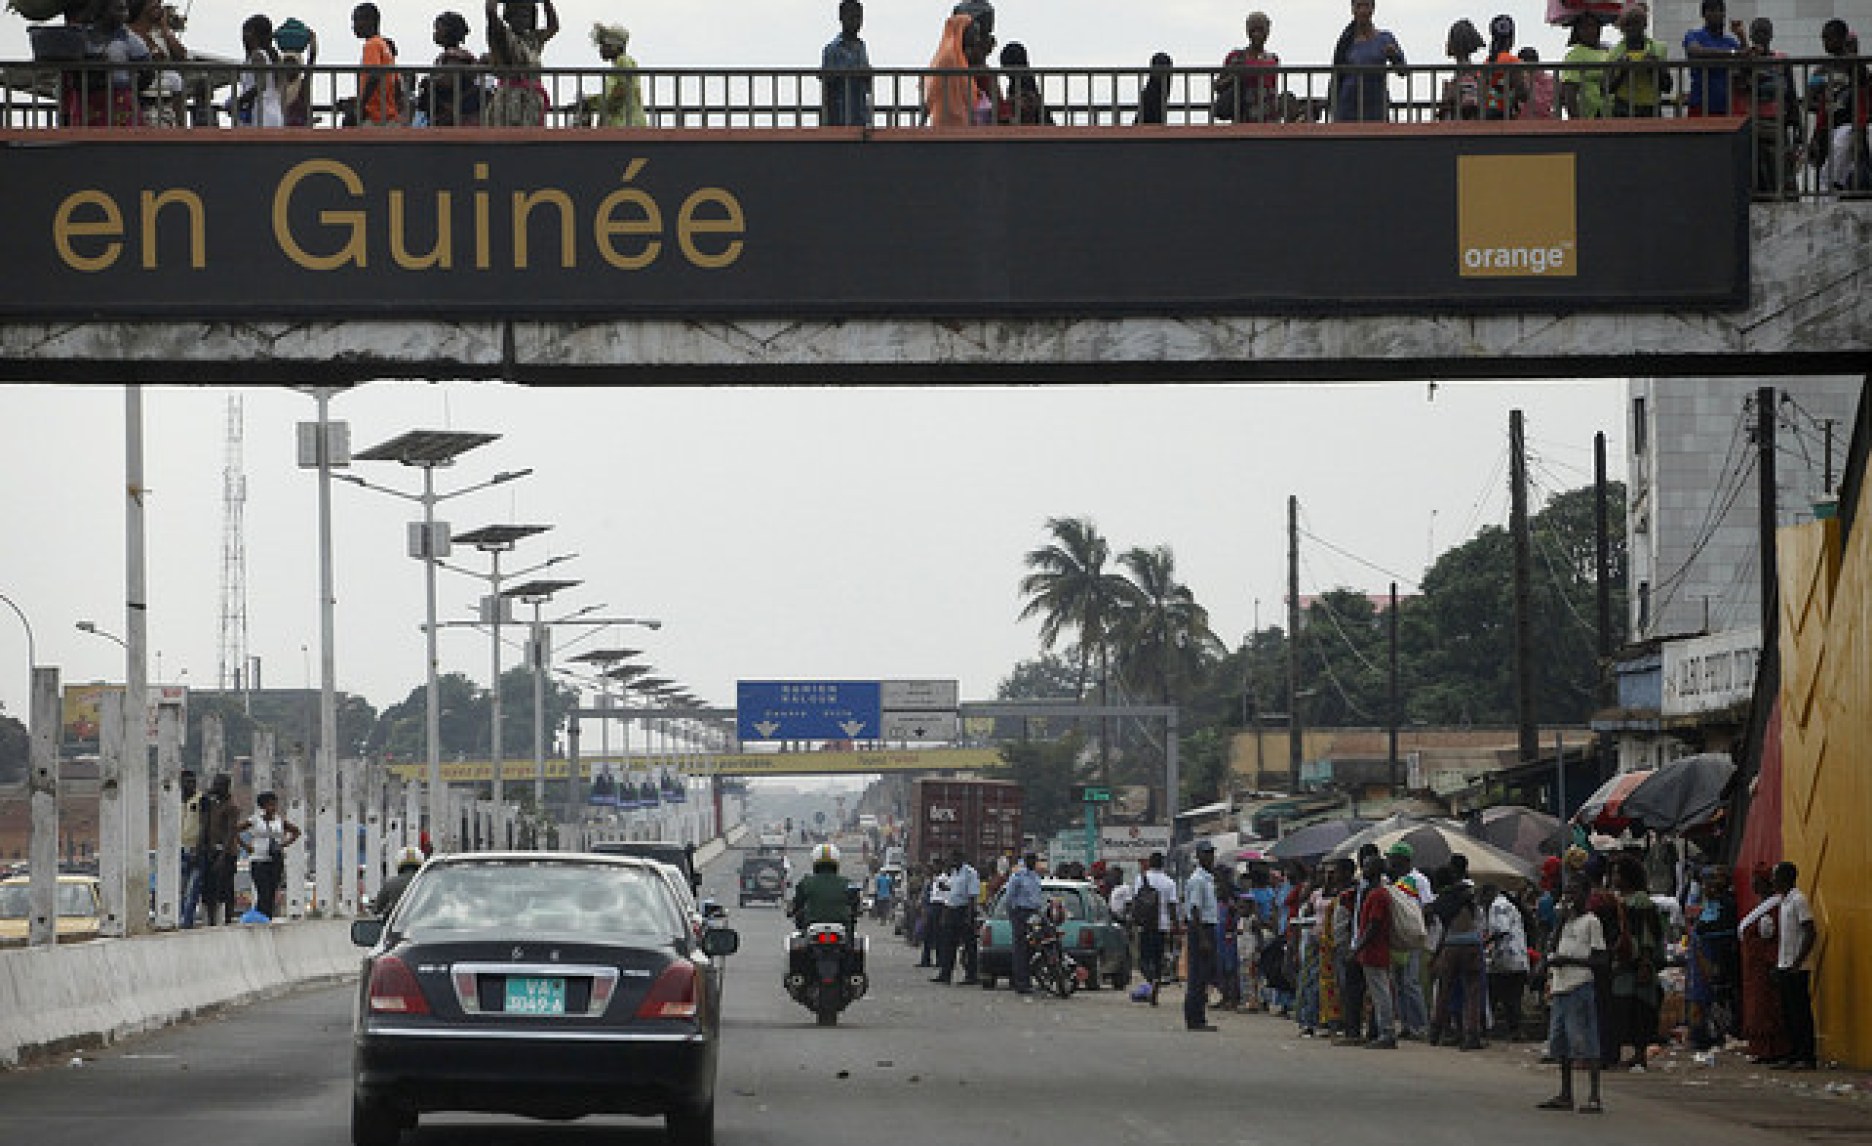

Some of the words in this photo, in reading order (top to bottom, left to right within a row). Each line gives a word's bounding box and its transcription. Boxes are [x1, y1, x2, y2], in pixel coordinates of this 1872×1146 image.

[53, 189, 206, 270] en
[272, 157, 746, 270] Guinée
[1464, 248, 1563, 273] orange
